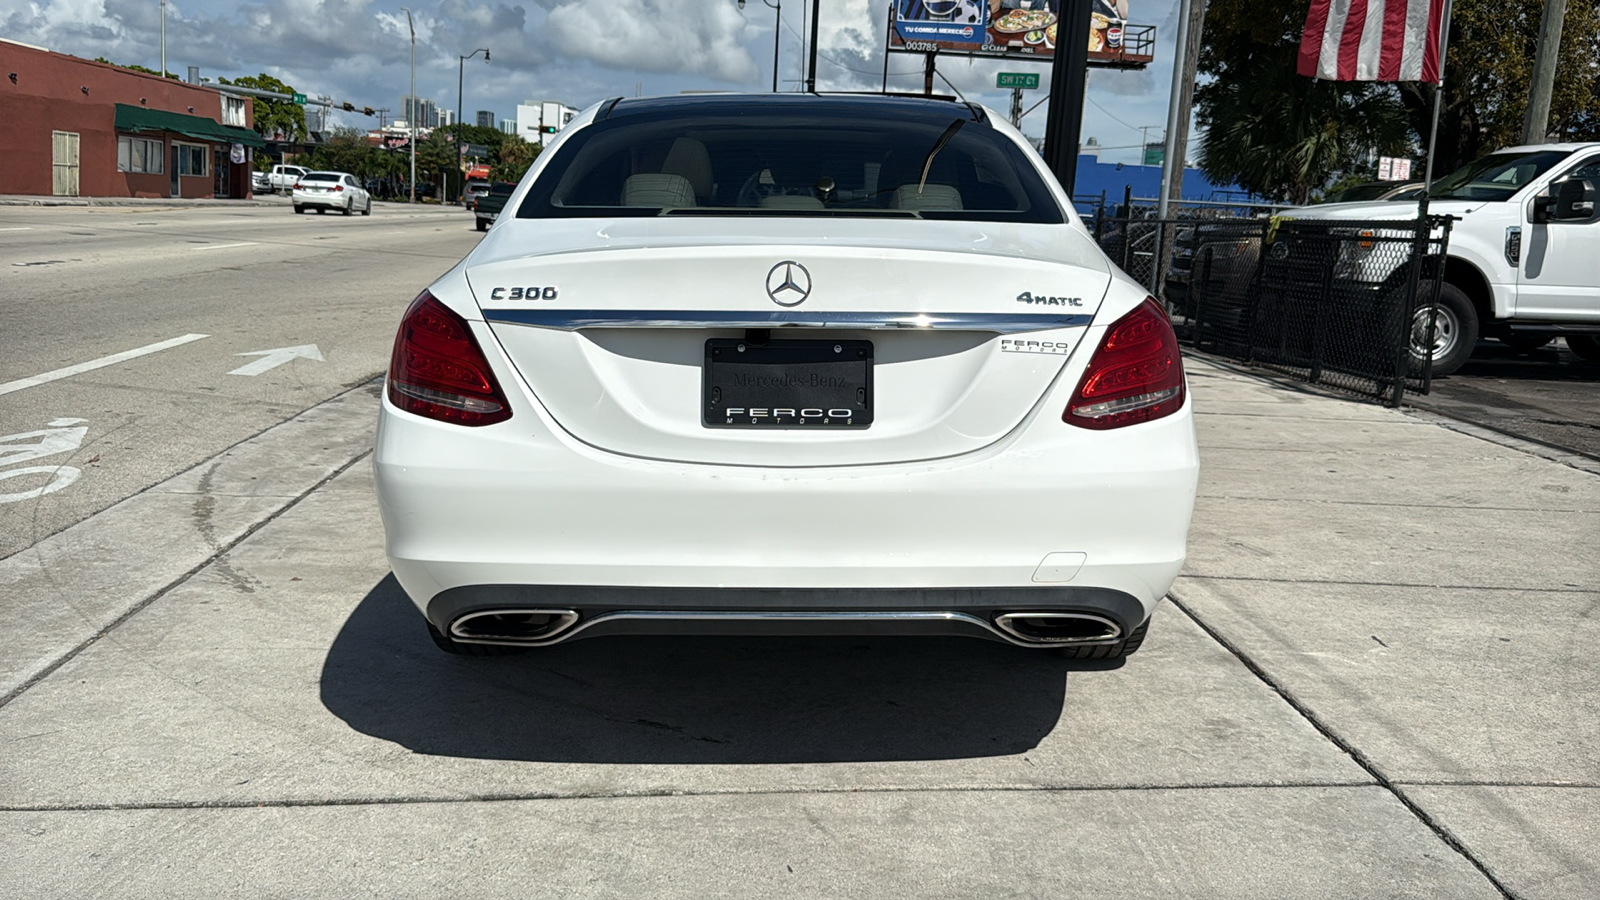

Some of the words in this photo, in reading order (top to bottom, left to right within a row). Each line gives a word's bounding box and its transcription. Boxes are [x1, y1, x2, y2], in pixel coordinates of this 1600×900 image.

[906, 42, 937, 52] 003785
[1002, 76, 1013, 84] SW
[1016, 76, 1024, 84] 17
[1026, 76, 1035, 85] Ct
[490, 287, 507, 300] C
[508, 286, 558, 300] 300
[1016, 291, 1083, 306] 4MATIC
[1002, 340, 1068, 348] FERCO
[733, 374, 846, 387] Mercedes-Benz
[726, 408, 852, 417] FERCO
